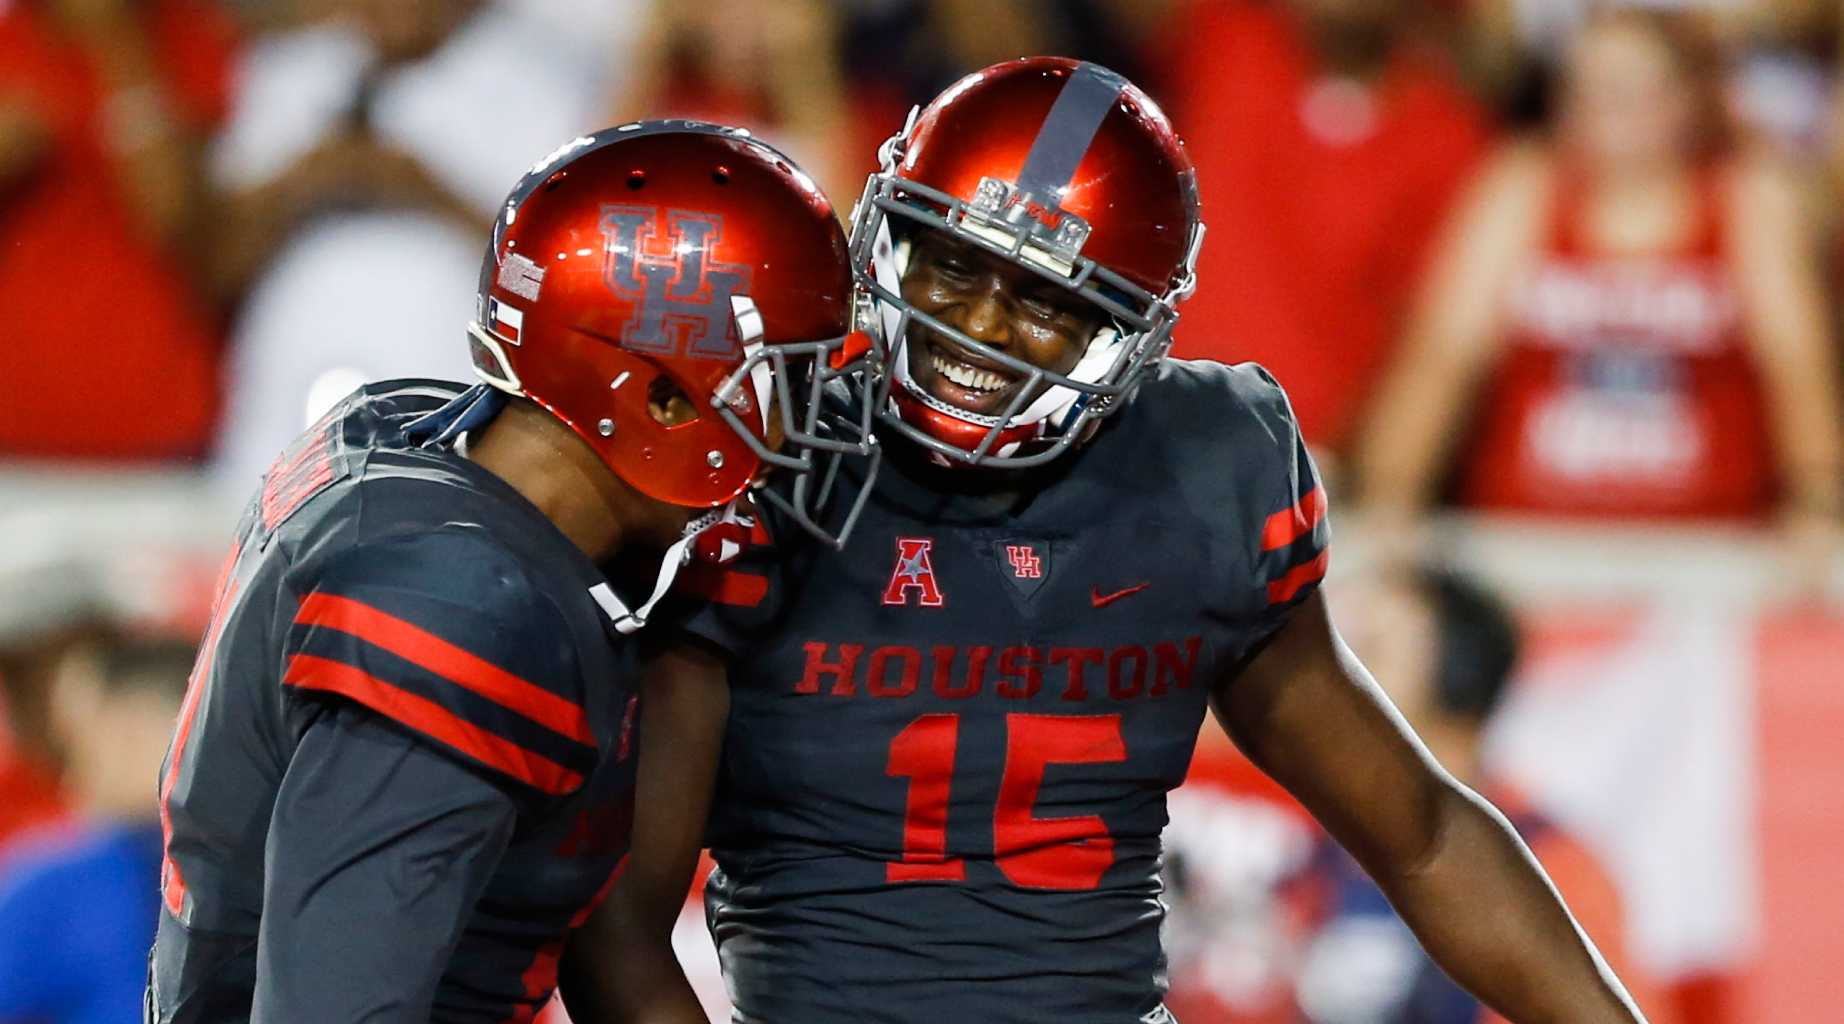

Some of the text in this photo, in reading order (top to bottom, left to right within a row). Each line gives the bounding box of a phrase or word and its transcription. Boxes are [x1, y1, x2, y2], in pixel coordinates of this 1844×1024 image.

[599, 204, 752, 360] UH
[881, 537, 943, 608] A
[1006, 545, 1041, 578] UH
[794, 636, 1203, 700] HOUSTON
[885, 712, 1127, 891] 15
